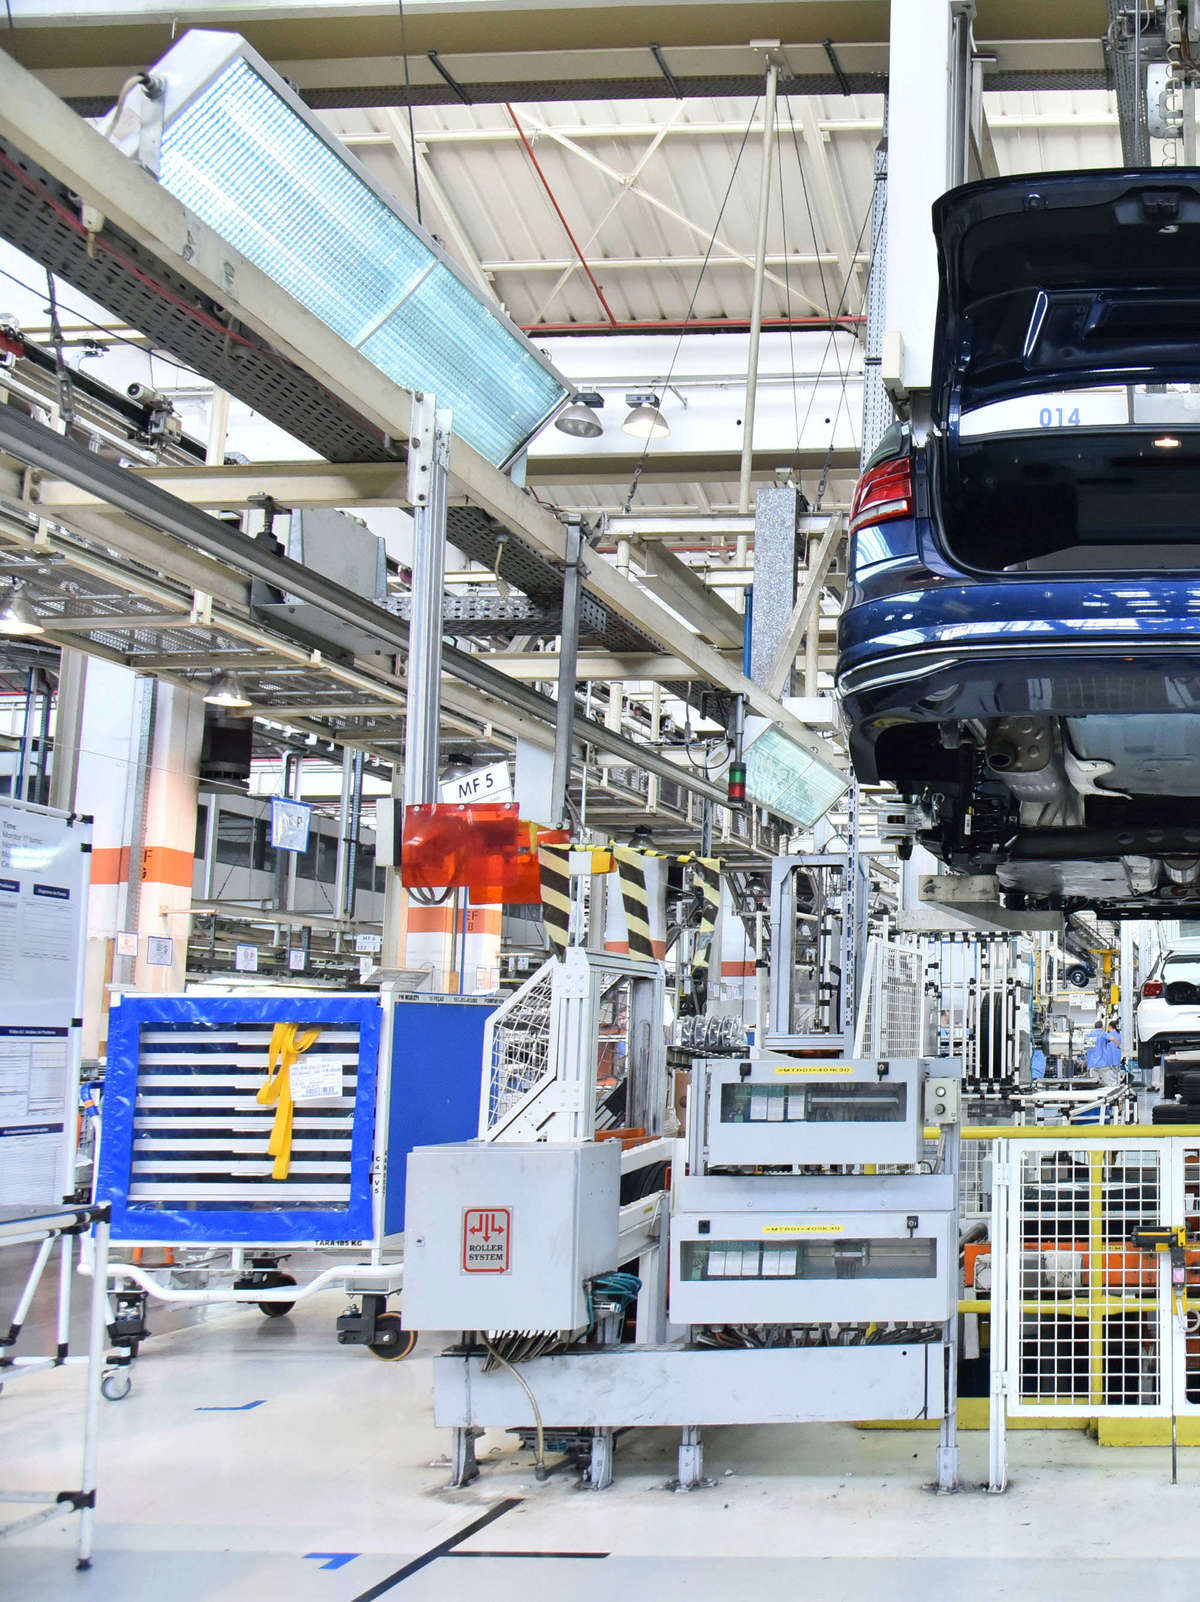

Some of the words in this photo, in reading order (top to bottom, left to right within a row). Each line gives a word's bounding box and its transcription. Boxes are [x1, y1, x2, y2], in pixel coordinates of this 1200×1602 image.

[1039, 407, 1081, 427] 014
[458, 778, 480, 798] MF
[485, 773, 494, 788] 5
[469, 1244, 503, 1252] ROLLER
[469, 1253, 504, 1261] SYSTEM
